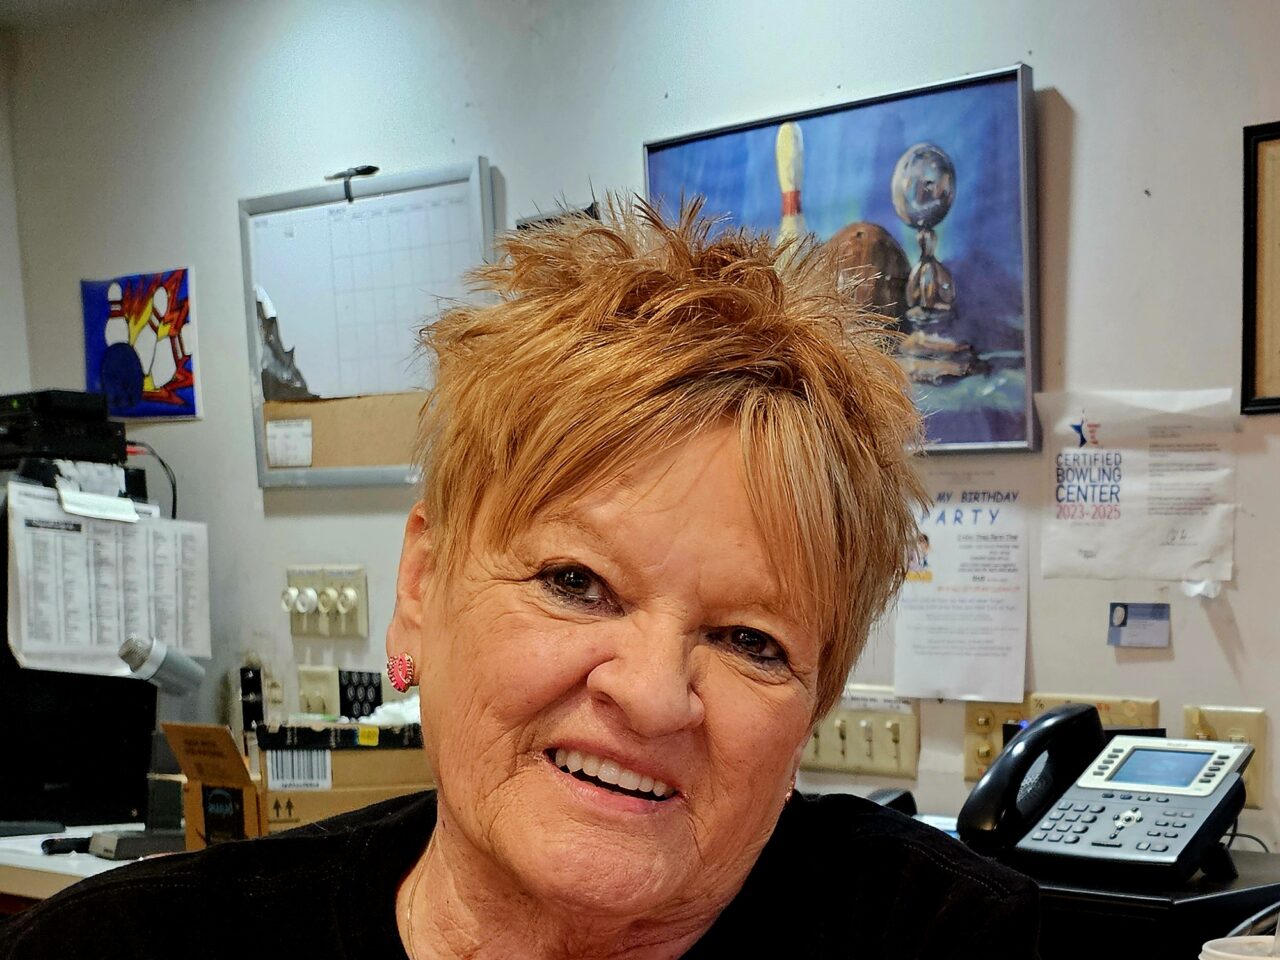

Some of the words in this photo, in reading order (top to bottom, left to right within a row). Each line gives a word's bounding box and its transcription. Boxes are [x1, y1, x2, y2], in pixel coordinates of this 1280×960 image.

[1056, 452, 1122, 467] CERTIFIED
[1056, 467, 1122, 484] BOWLING
[936, 491, 954, 502] MY
[961, 491, 1020, 503] BIRTHDAY
[1055, 484, 1121, 503] CENTER
[1056, 505, 1121, 520] 2023-2025
